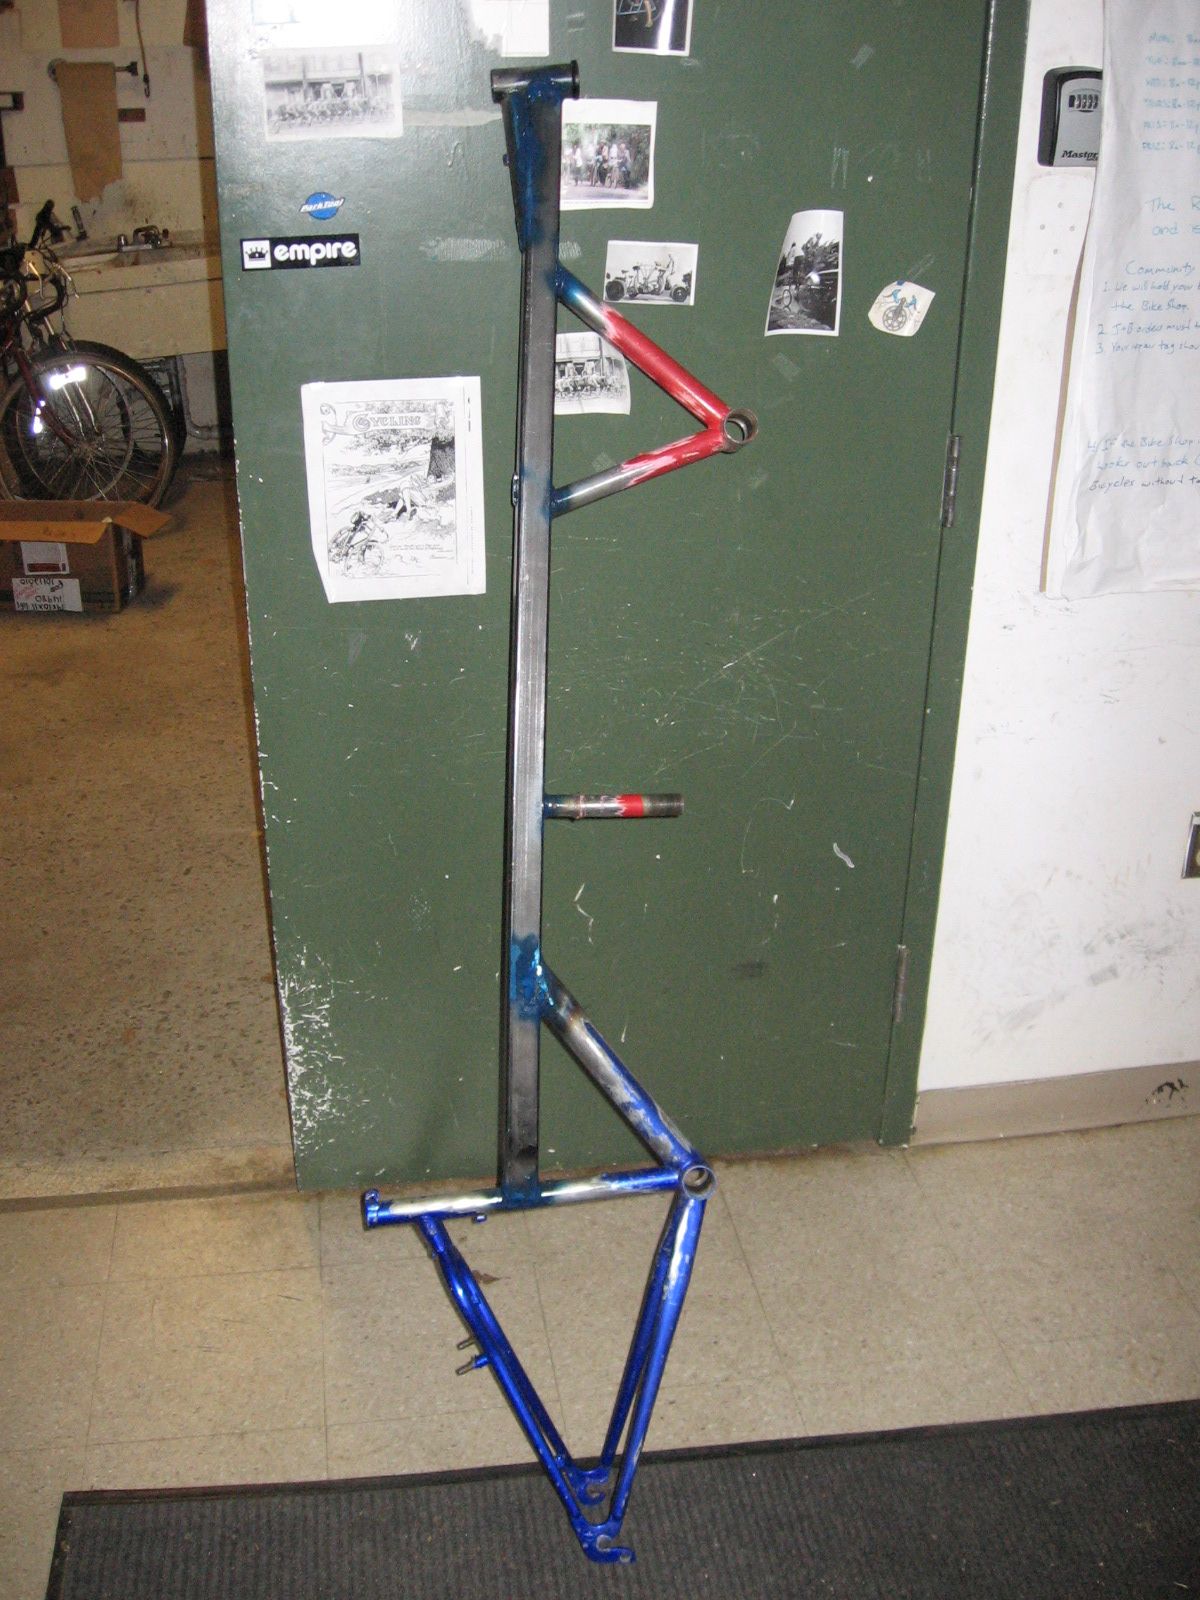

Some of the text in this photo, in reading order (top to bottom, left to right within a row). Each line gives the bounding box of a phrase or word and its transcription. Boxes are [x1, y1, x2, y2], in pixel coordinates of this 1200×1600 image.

[1062, 150, 1098, 159] Master
[274, 241, 357, 266] empire
[352, 413, 421, 431] CYCLING
